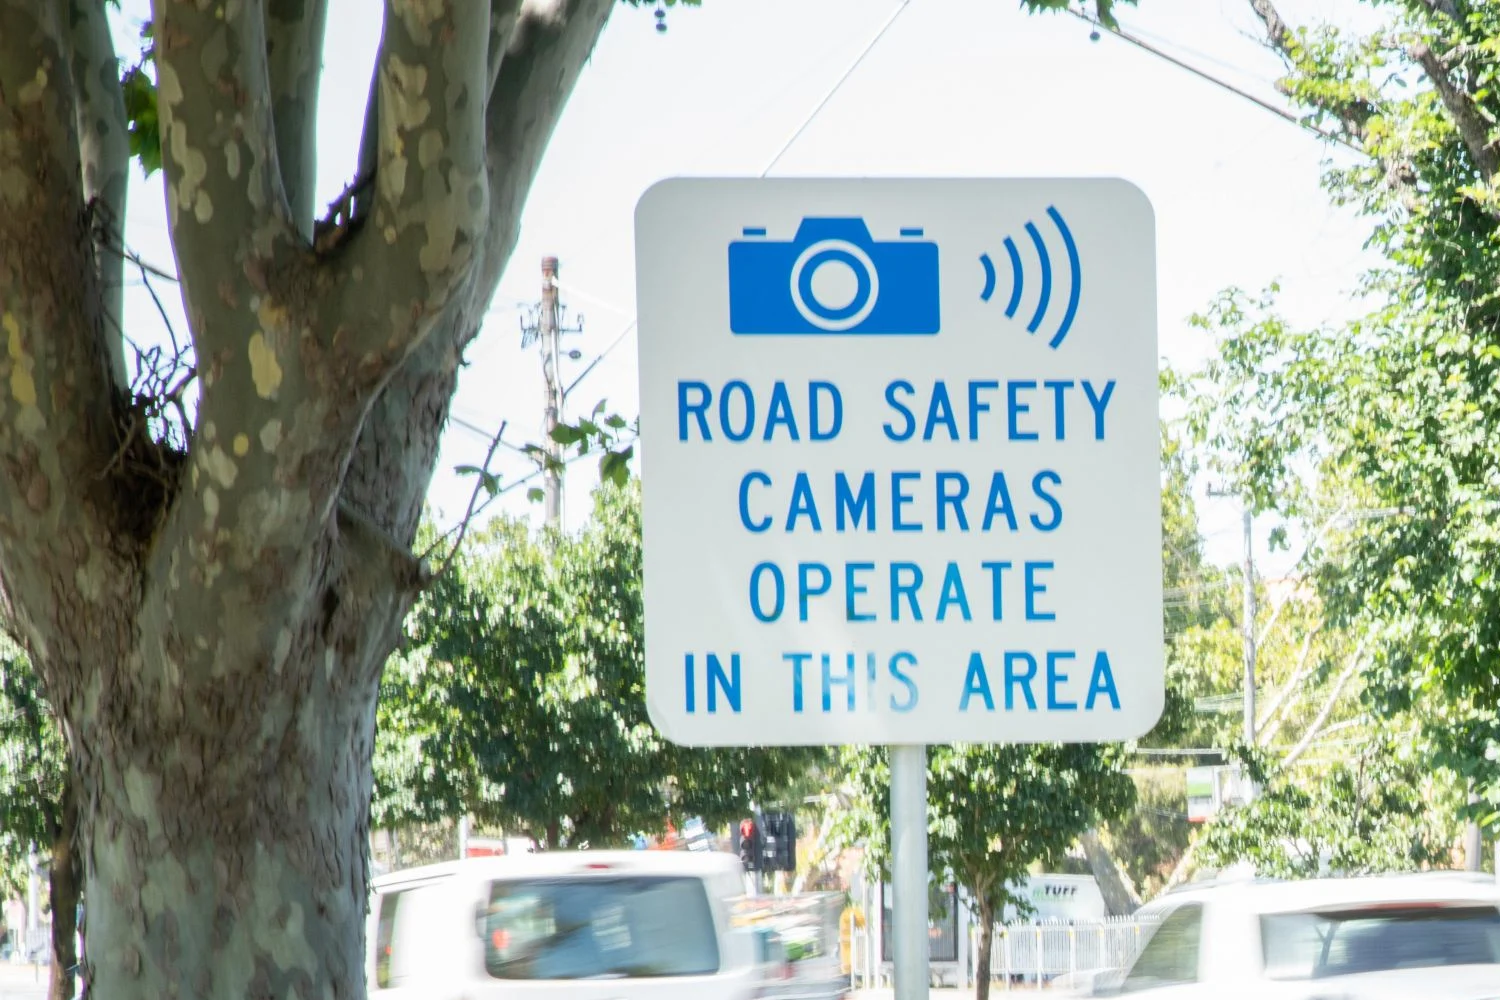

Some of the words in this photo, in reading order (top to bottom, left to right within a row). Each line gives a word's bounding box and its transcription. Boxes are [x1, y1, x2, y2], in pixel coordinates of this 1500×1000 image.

[677, 378, 844, 443] ROAD
[882, 378, 1117, 443] SAFETY
[738, 468, 1064, 534] CAMERAS
[748, 560, 1057, 624] OPERATE
[683, 652, 743, 714] IN
[781, 650, 919, 714] THIS
[958, 649, 1122, 713] AREA
